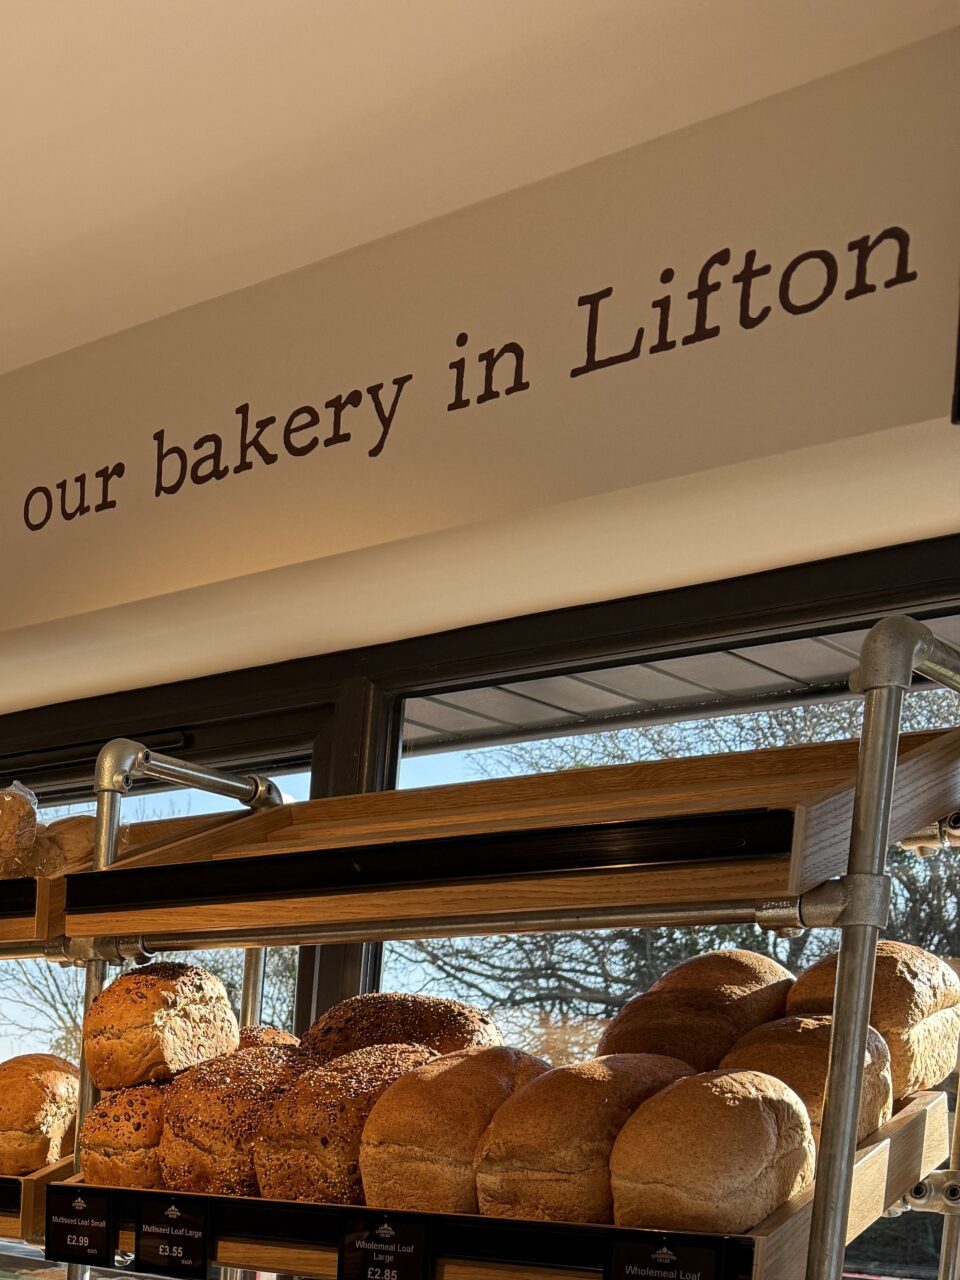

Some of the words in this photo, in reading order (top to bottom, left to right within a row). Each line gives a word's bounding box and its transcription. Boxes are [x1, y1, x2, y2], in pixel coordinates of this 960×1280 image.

[23, 461, 127, 532] our
[153, 373, 413, 498] bakery
[447, 332, 531, 411] in
[570, 225, 918, 378] Lifton
[90, 1219, 106, 1228] Small
[142, 1224, 170, 1234] Multiseed
[170, 1227, 185, 1236] Loaf
[185, 1228, 203, 1239] Large
[67, 1234, 89, 1246] £2.99
[355, 1240, 396, 1252] Wholemeal
[397, 1245, 414, 1253] Loaf
[159, 1244, 183, 1257] £3.55
[373, 1252, 394, 1263] Large
[367, 1267, 398, 1280] £2.85
[625, 1265, 677, 1279] Wholemeal
[680, 1270, 702, 1280] Loaf
